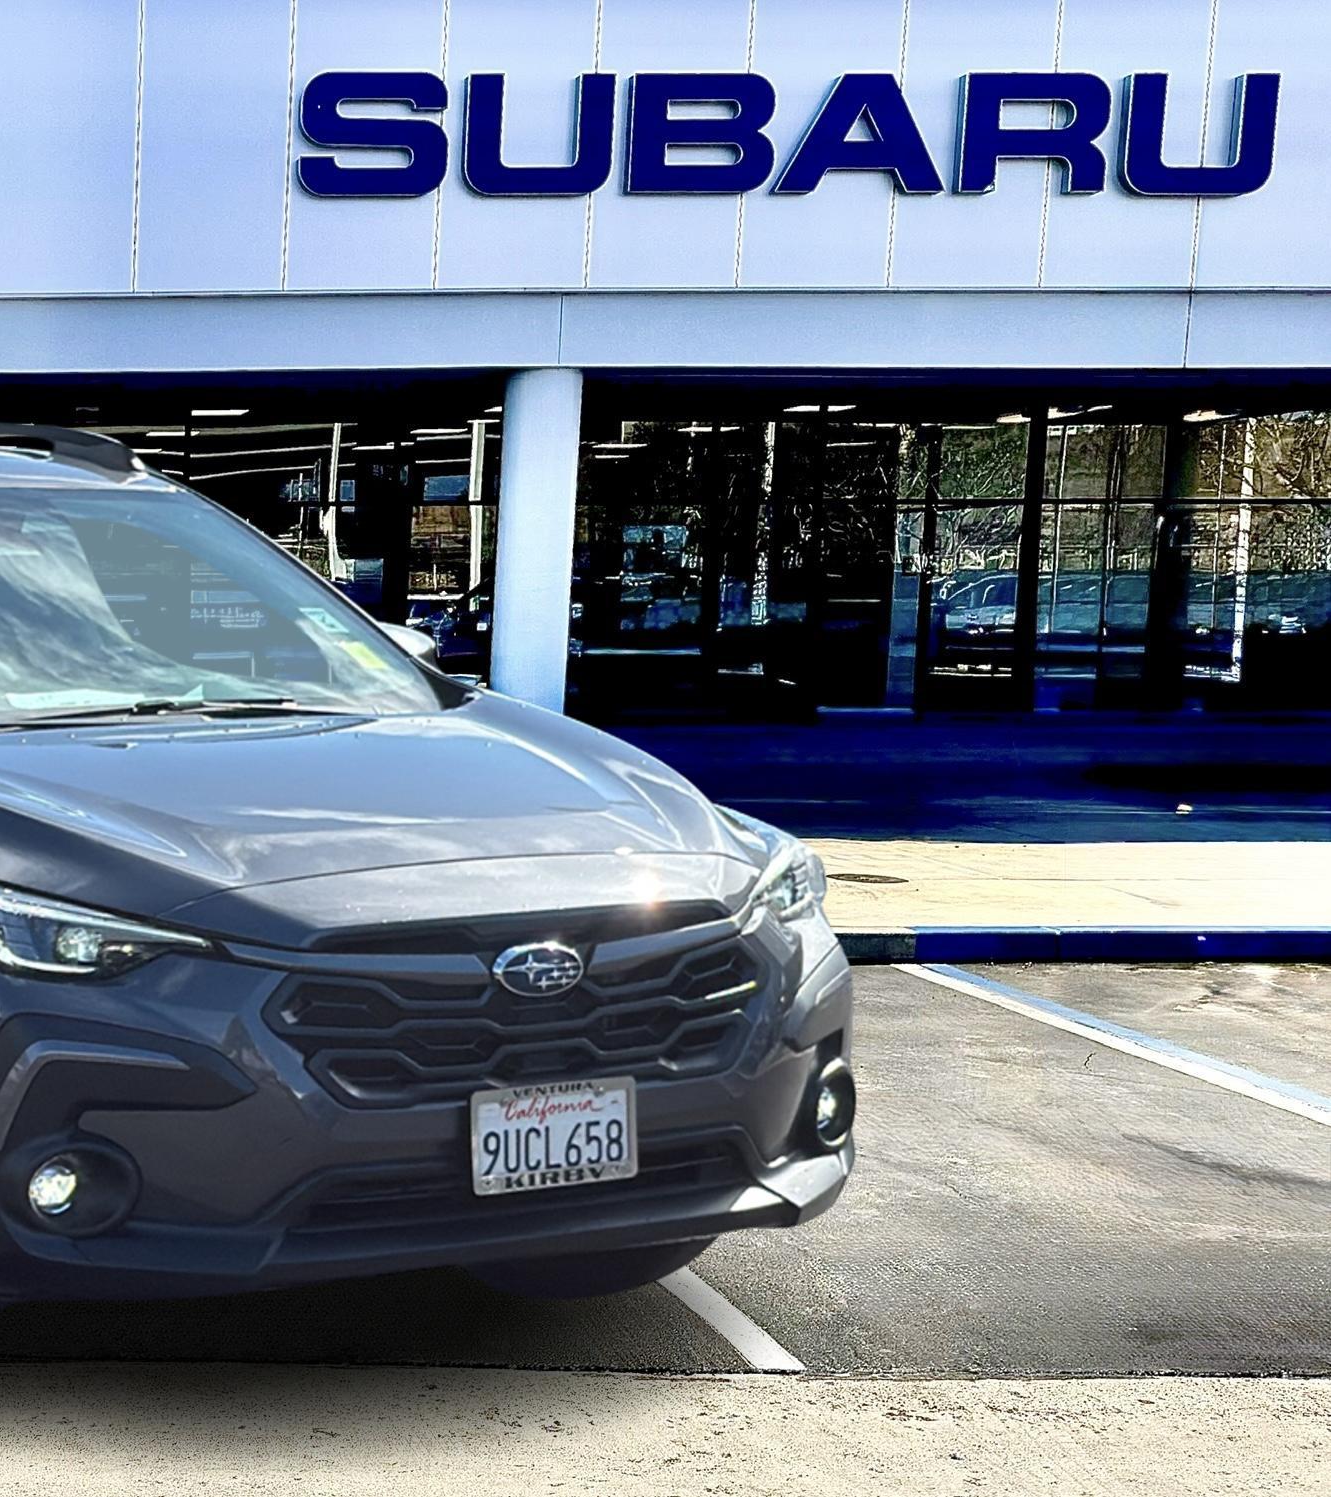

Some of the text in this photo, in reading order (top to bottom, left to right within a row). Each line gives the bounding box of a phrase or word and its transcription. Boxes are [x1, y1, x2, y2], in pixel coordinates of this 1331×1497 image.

[298, 71, 1281, 198] SUBARU
[513, 1082, 595, 1098] VENTURA
[504, 1095, 604, 1124] California
[482, 1118, 624, 1176] 9UCL658
[505, 1165, 607, 1189] KIRBY
